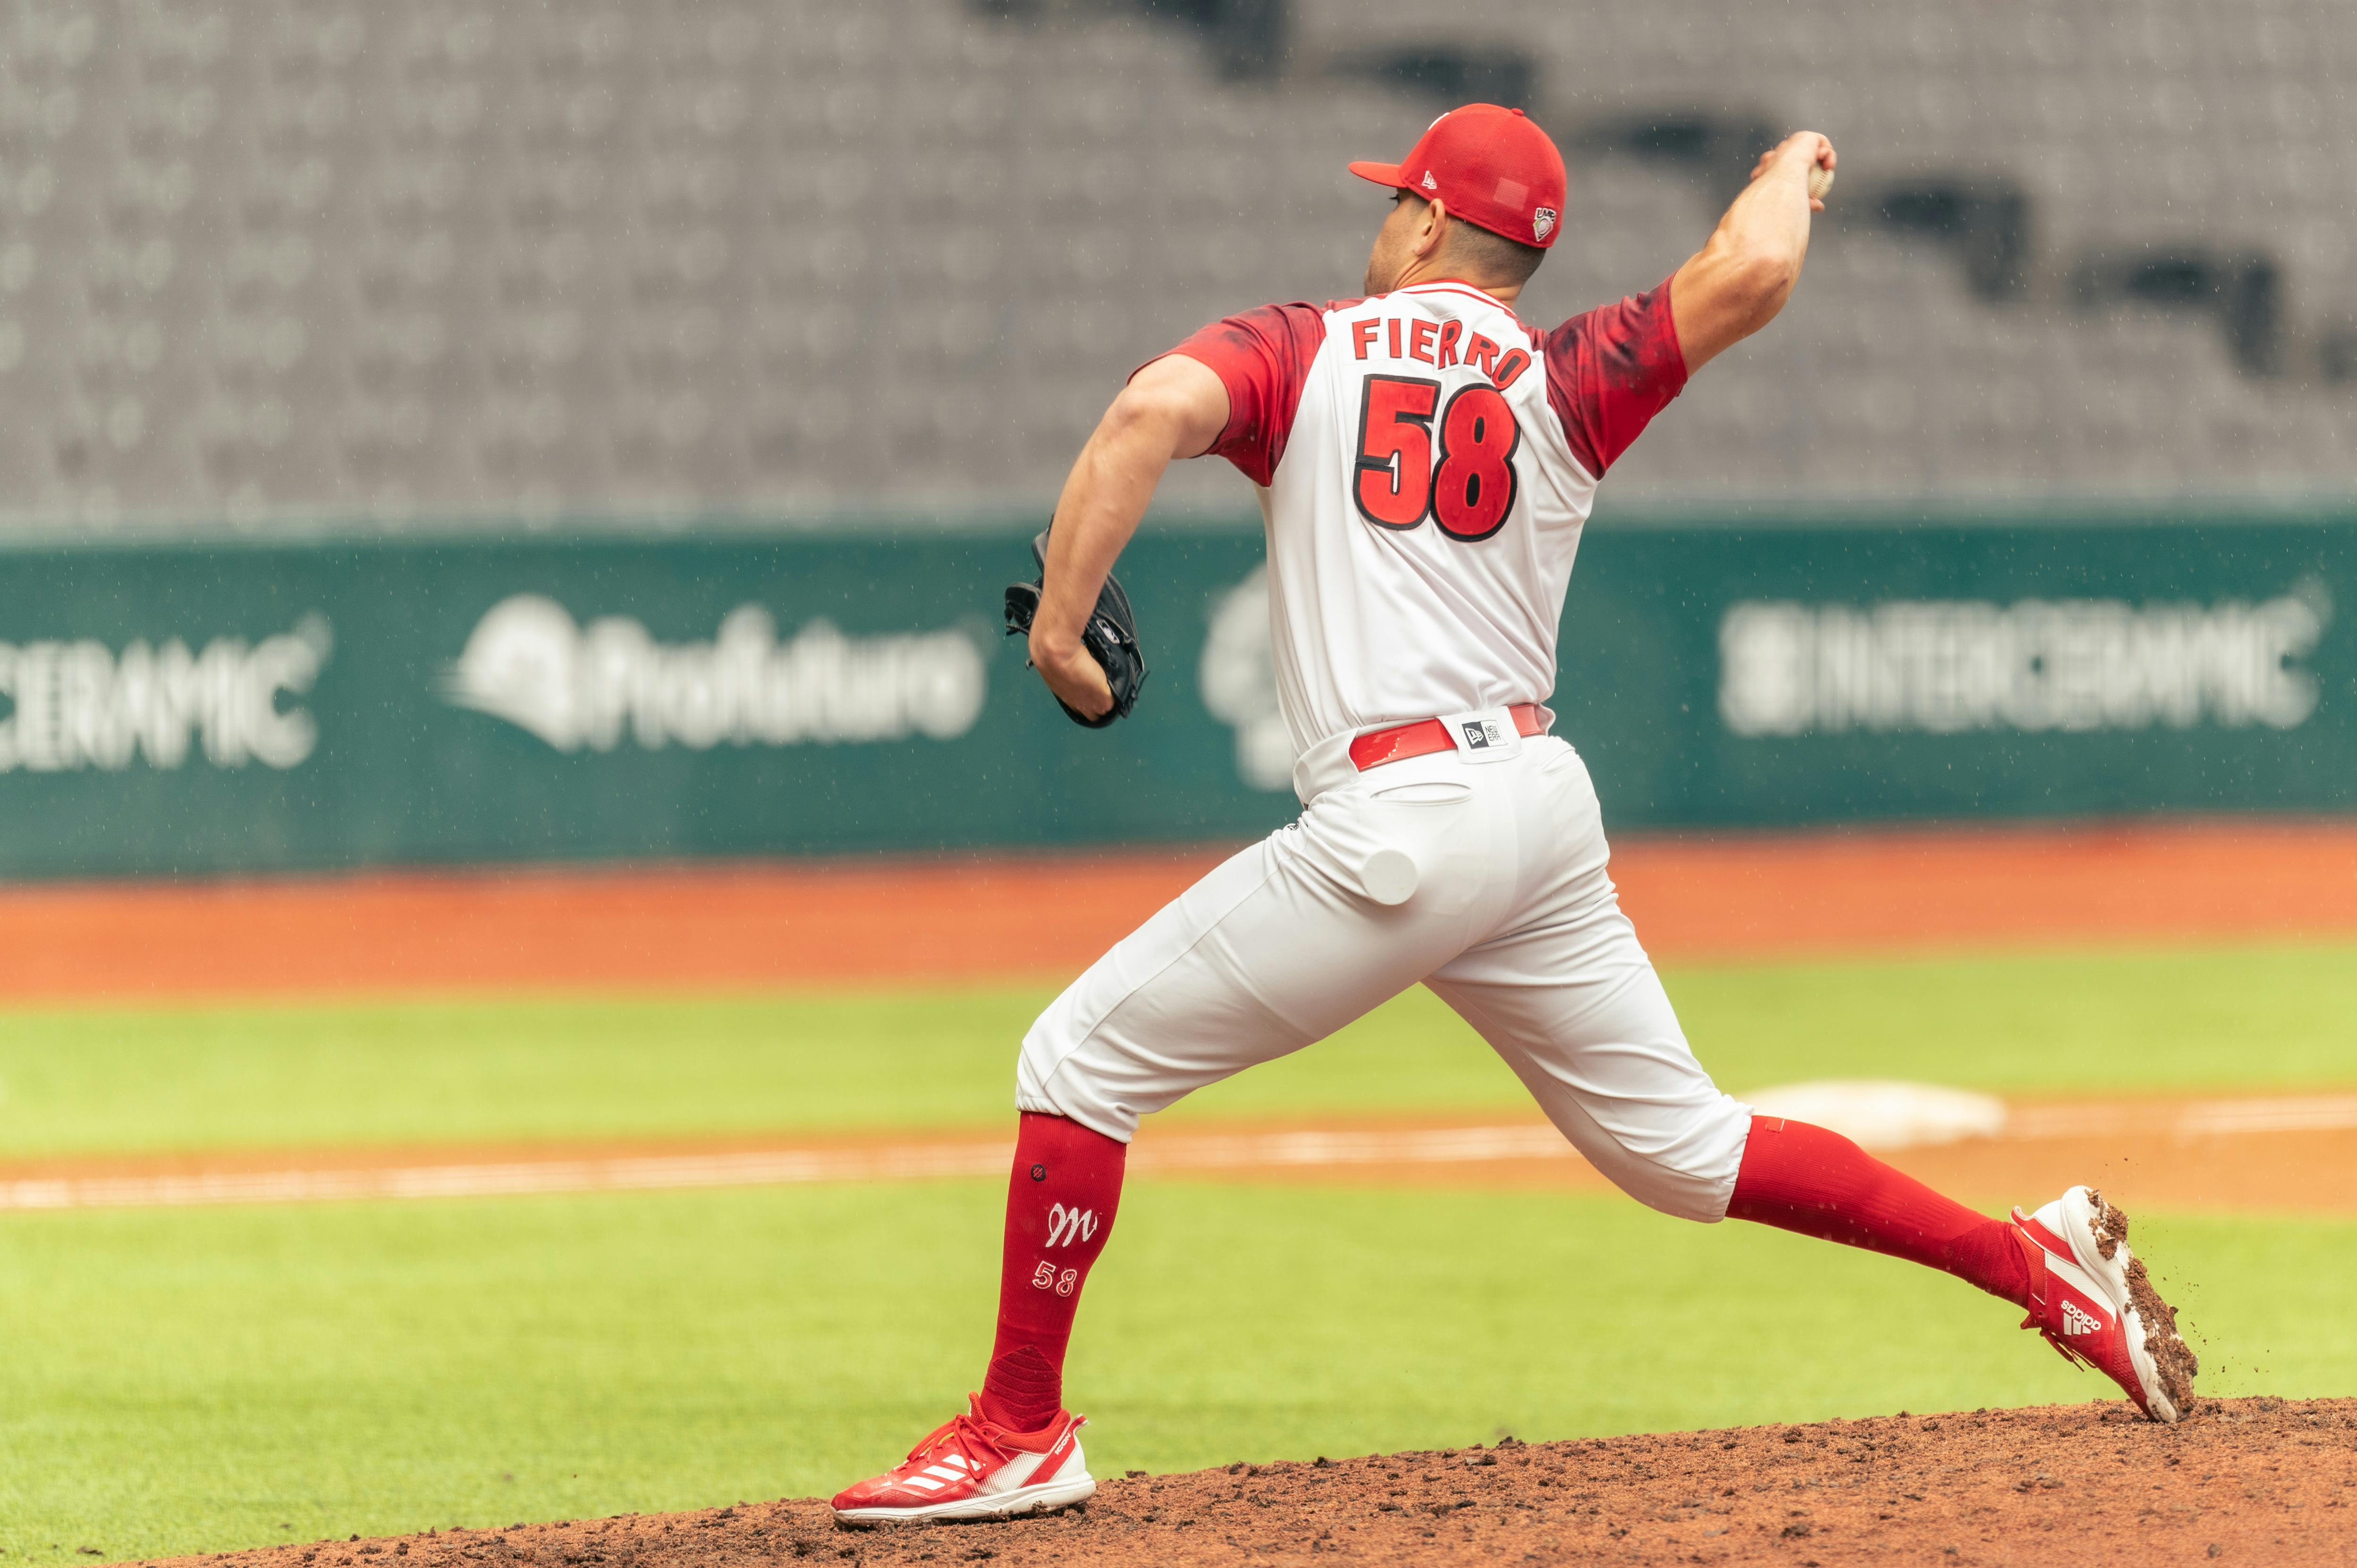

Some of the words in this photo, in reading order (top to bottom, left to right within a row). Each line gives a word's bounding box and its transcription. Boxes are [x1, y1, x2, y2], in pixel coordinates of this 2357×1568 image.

[1352, 317, 1531, 391] FIERRO
[1353, 373, 1521, 542] 58
[1485, 725, 1498, 733] NEW
[1487, 733, 1502, 741] ERA
[1032, 1260, 1077, 1297] 58
[2061, 1300, 2102, 1331] adidas
[1054, 1432, 1071, 1456] ICON
